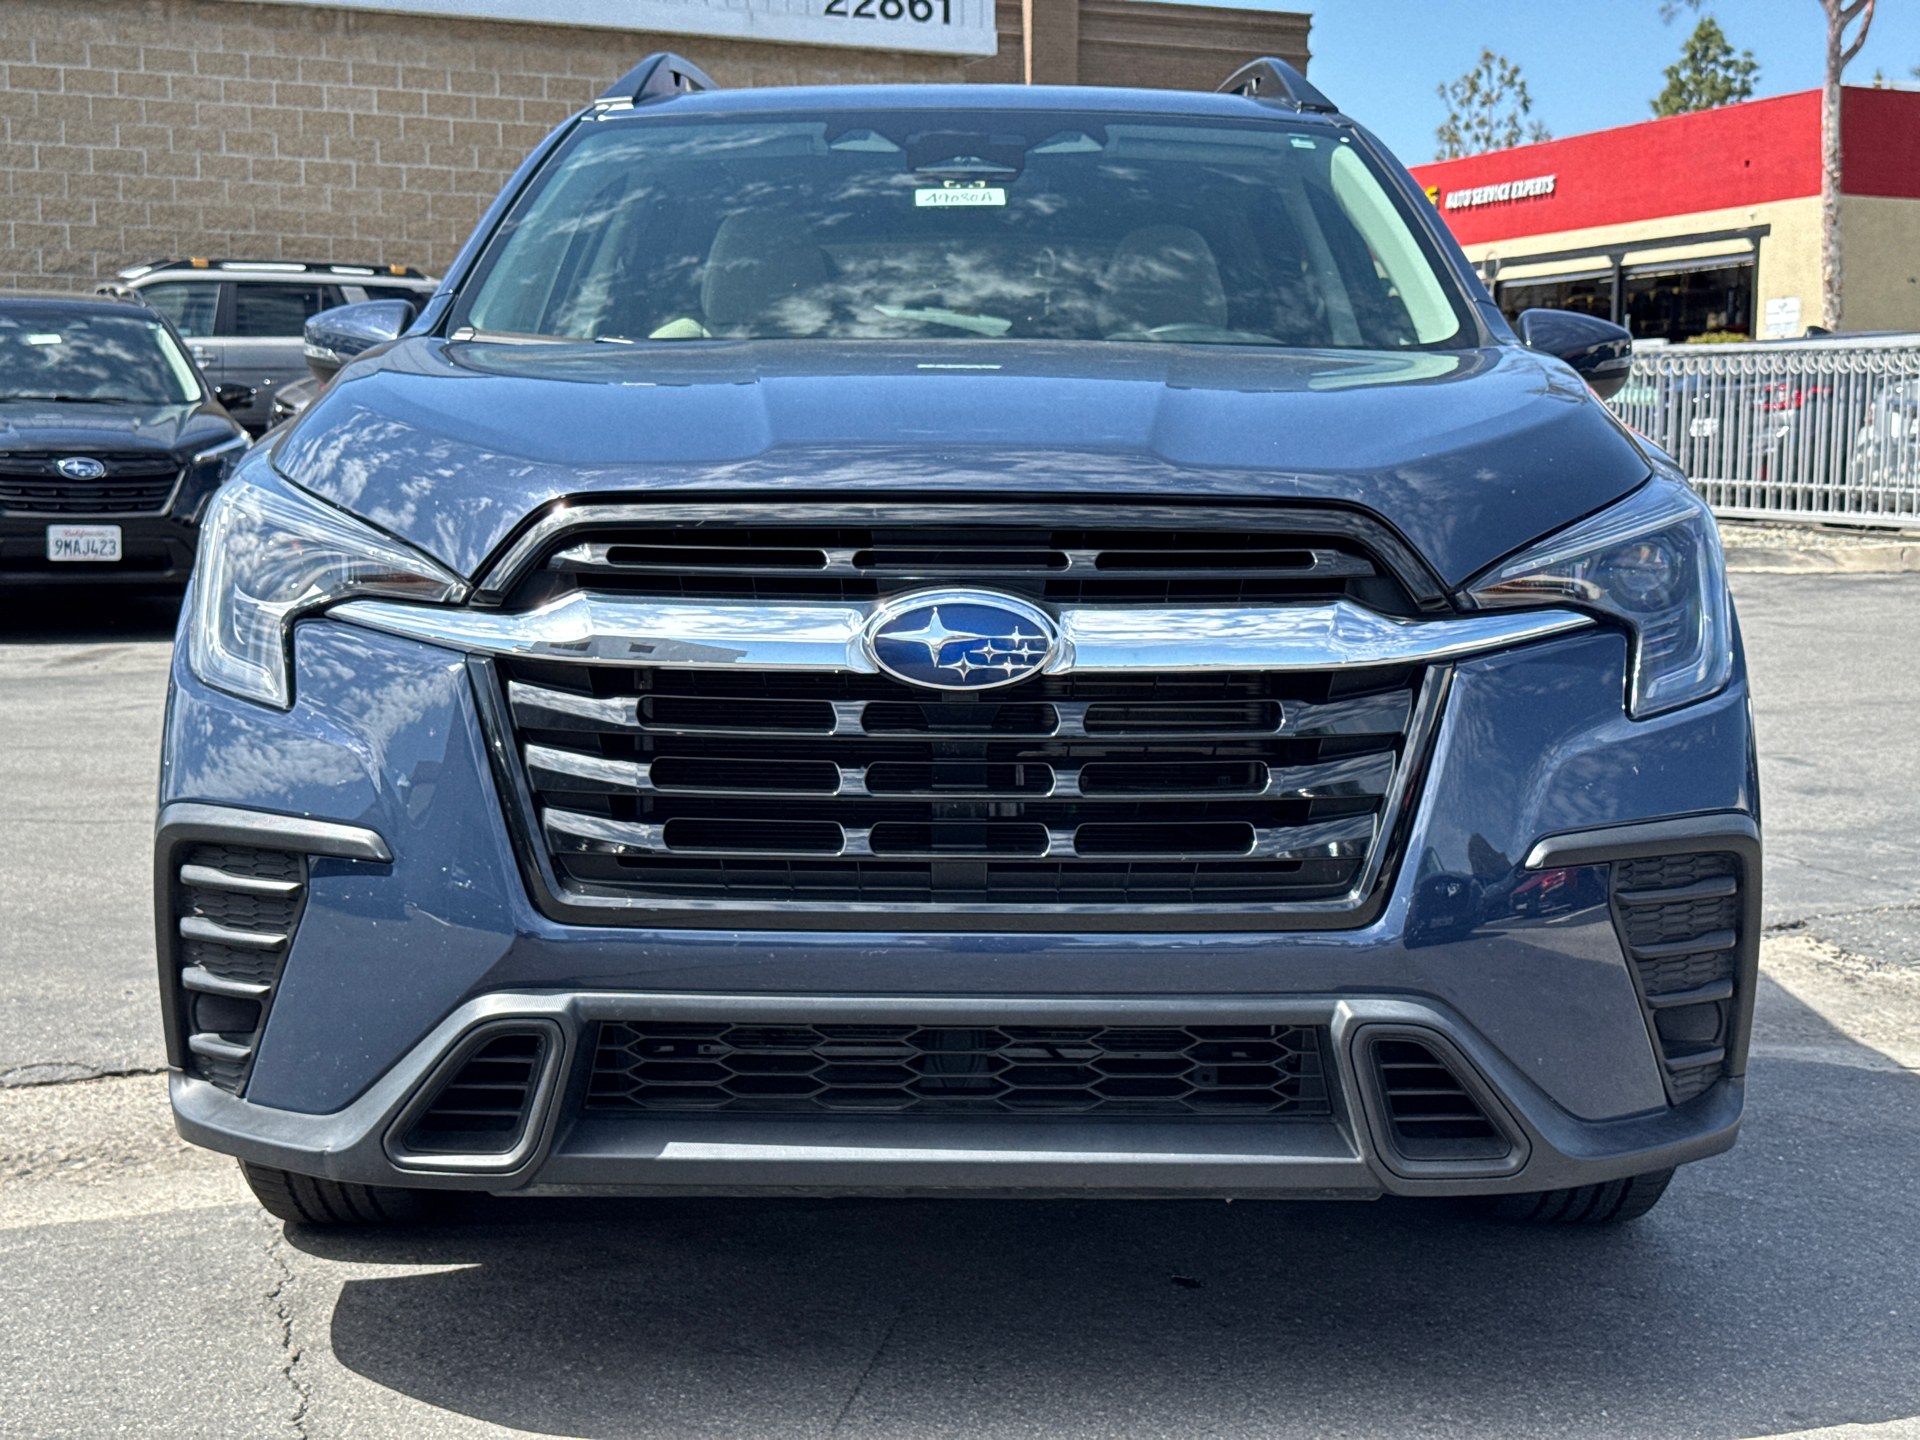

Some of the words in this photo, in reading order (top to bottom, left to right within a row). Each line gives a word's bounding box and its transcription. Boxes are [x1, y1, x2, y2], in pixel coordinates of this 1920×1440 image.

[1445, 190, 1472, 209] AUTO
[1471, 182, 1511, 206] SERVICE
[1511, 174, 1556, 199] EXPERTS
[55, 540, 117, 556] 9MAJ423
